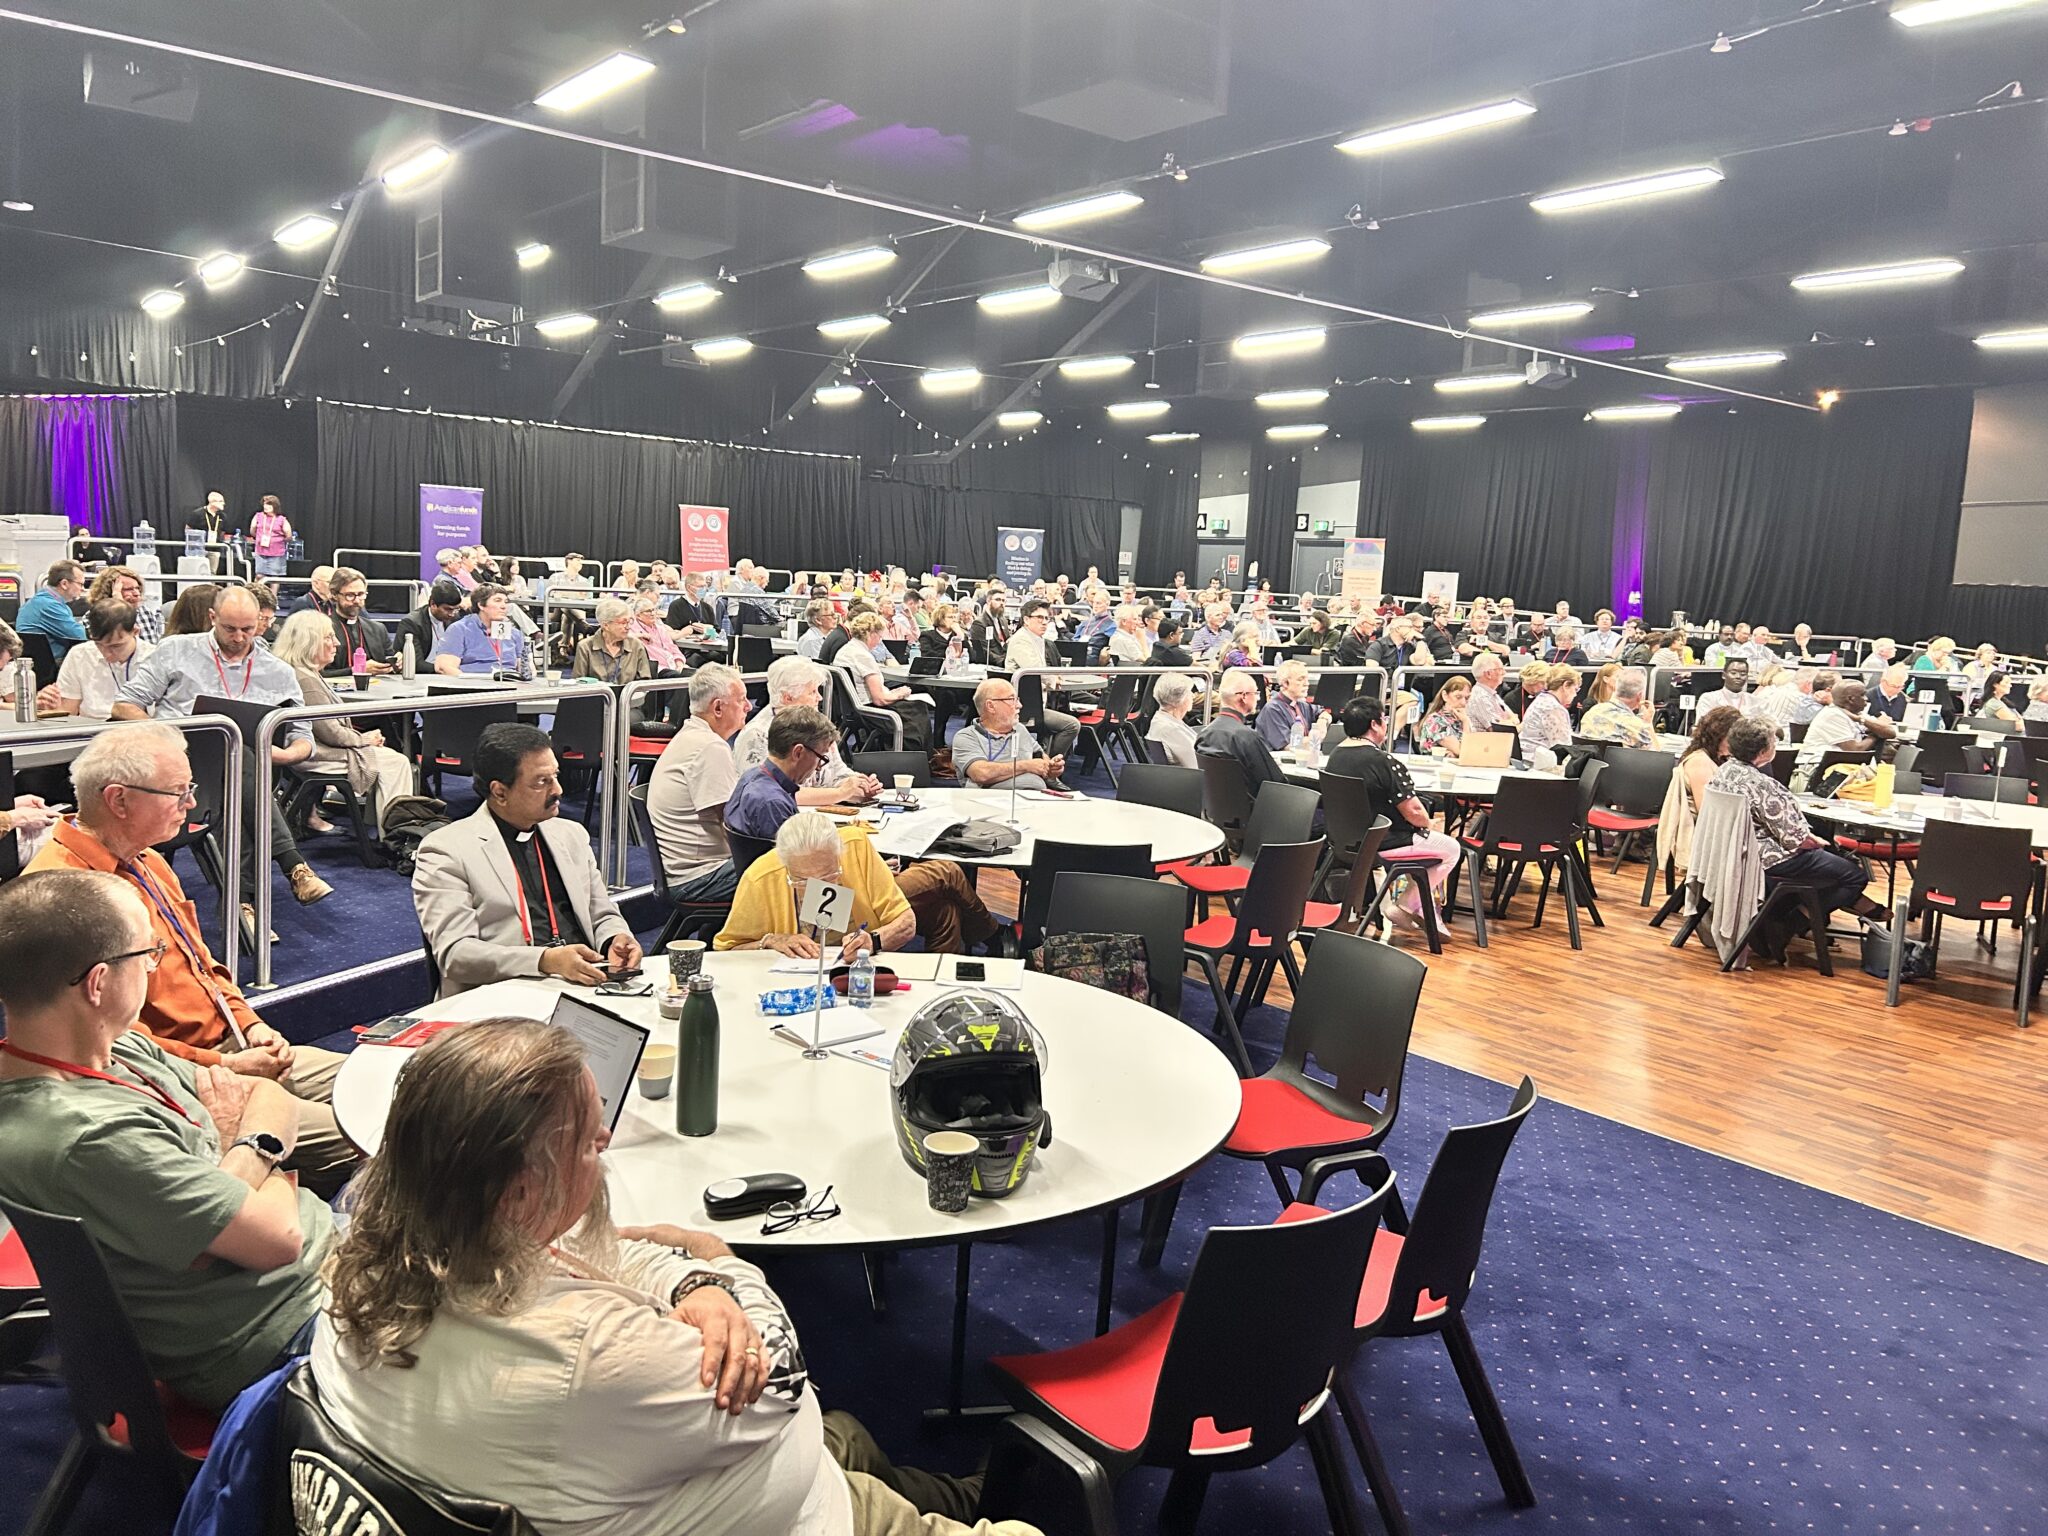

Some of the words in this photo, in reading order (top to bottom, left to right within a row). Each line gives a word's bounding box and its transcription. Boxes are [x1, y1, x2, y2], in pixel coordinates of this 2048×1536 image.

[1197, 514, 1206, 529] A
[1297, 515, 1308, 530] B
[498, 623, 505, 634] 3
[1684, 696, 1690, 706] 9
[818, 886, 837, 917] 2
